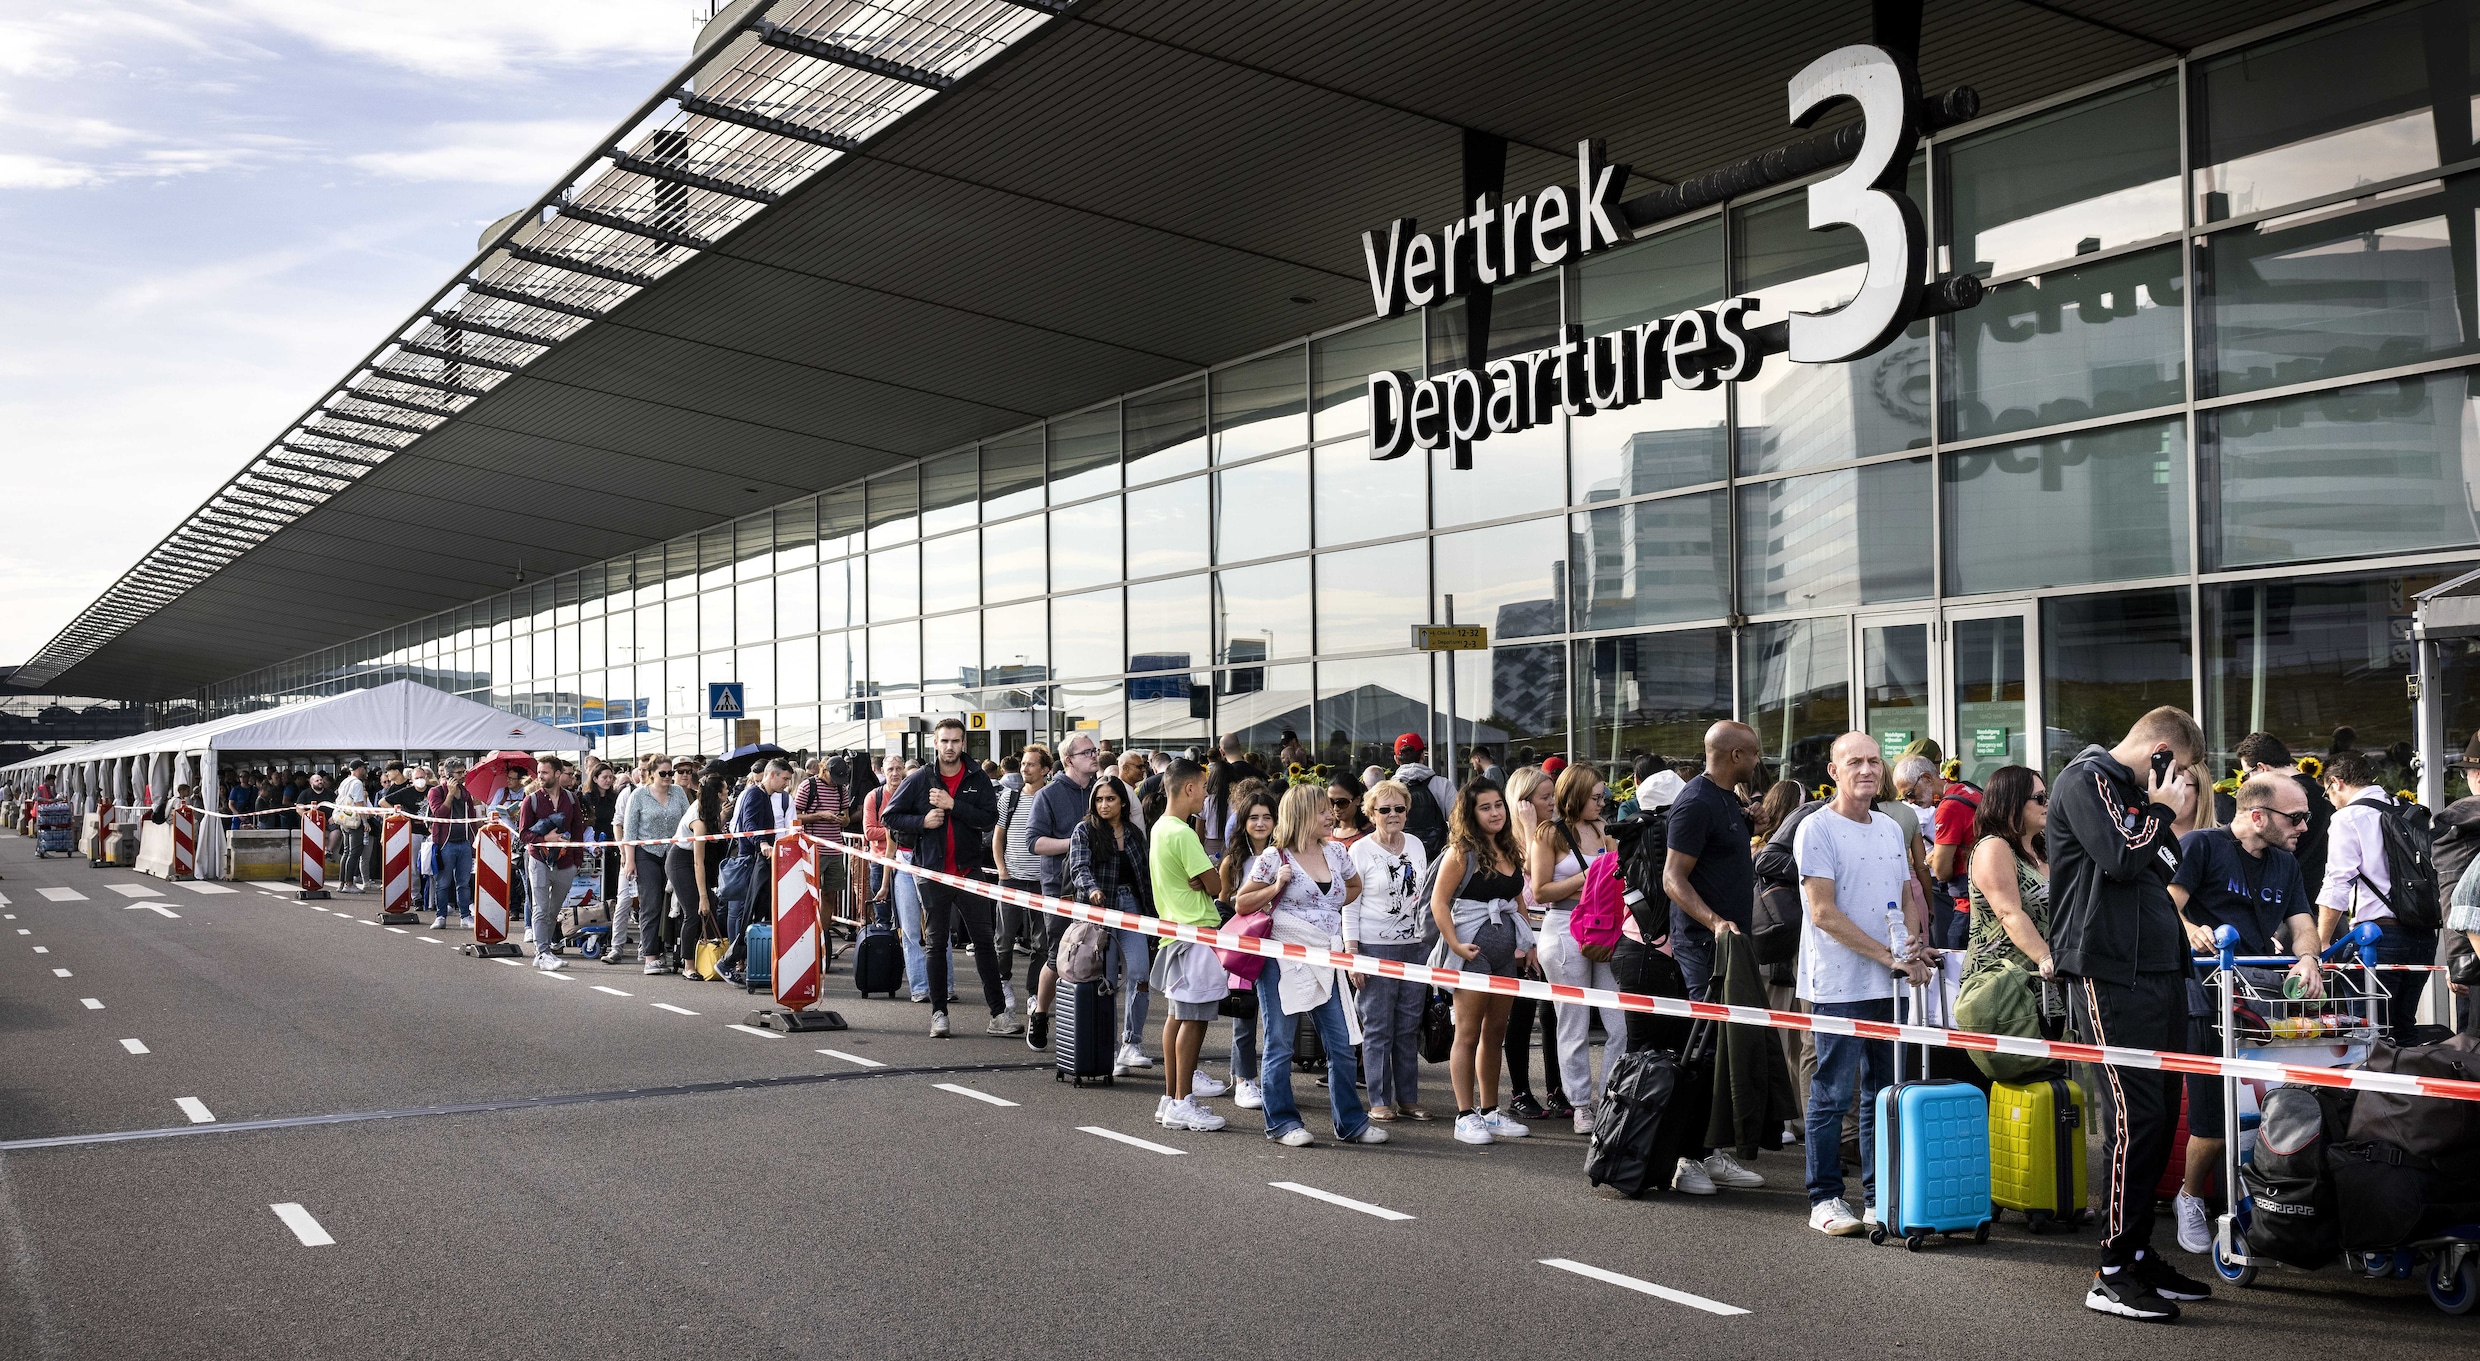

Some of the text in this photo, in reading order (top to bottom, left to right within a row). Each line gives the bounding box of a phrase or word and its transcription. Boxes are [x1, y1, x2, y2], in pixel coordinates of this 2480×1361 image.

[1362, 138, 1628, 318] Vertrek
[1788, 43, 1918, 363] 3
[1369, 297, 1756, 469] Departures
[973, 715, 983, 728] D
